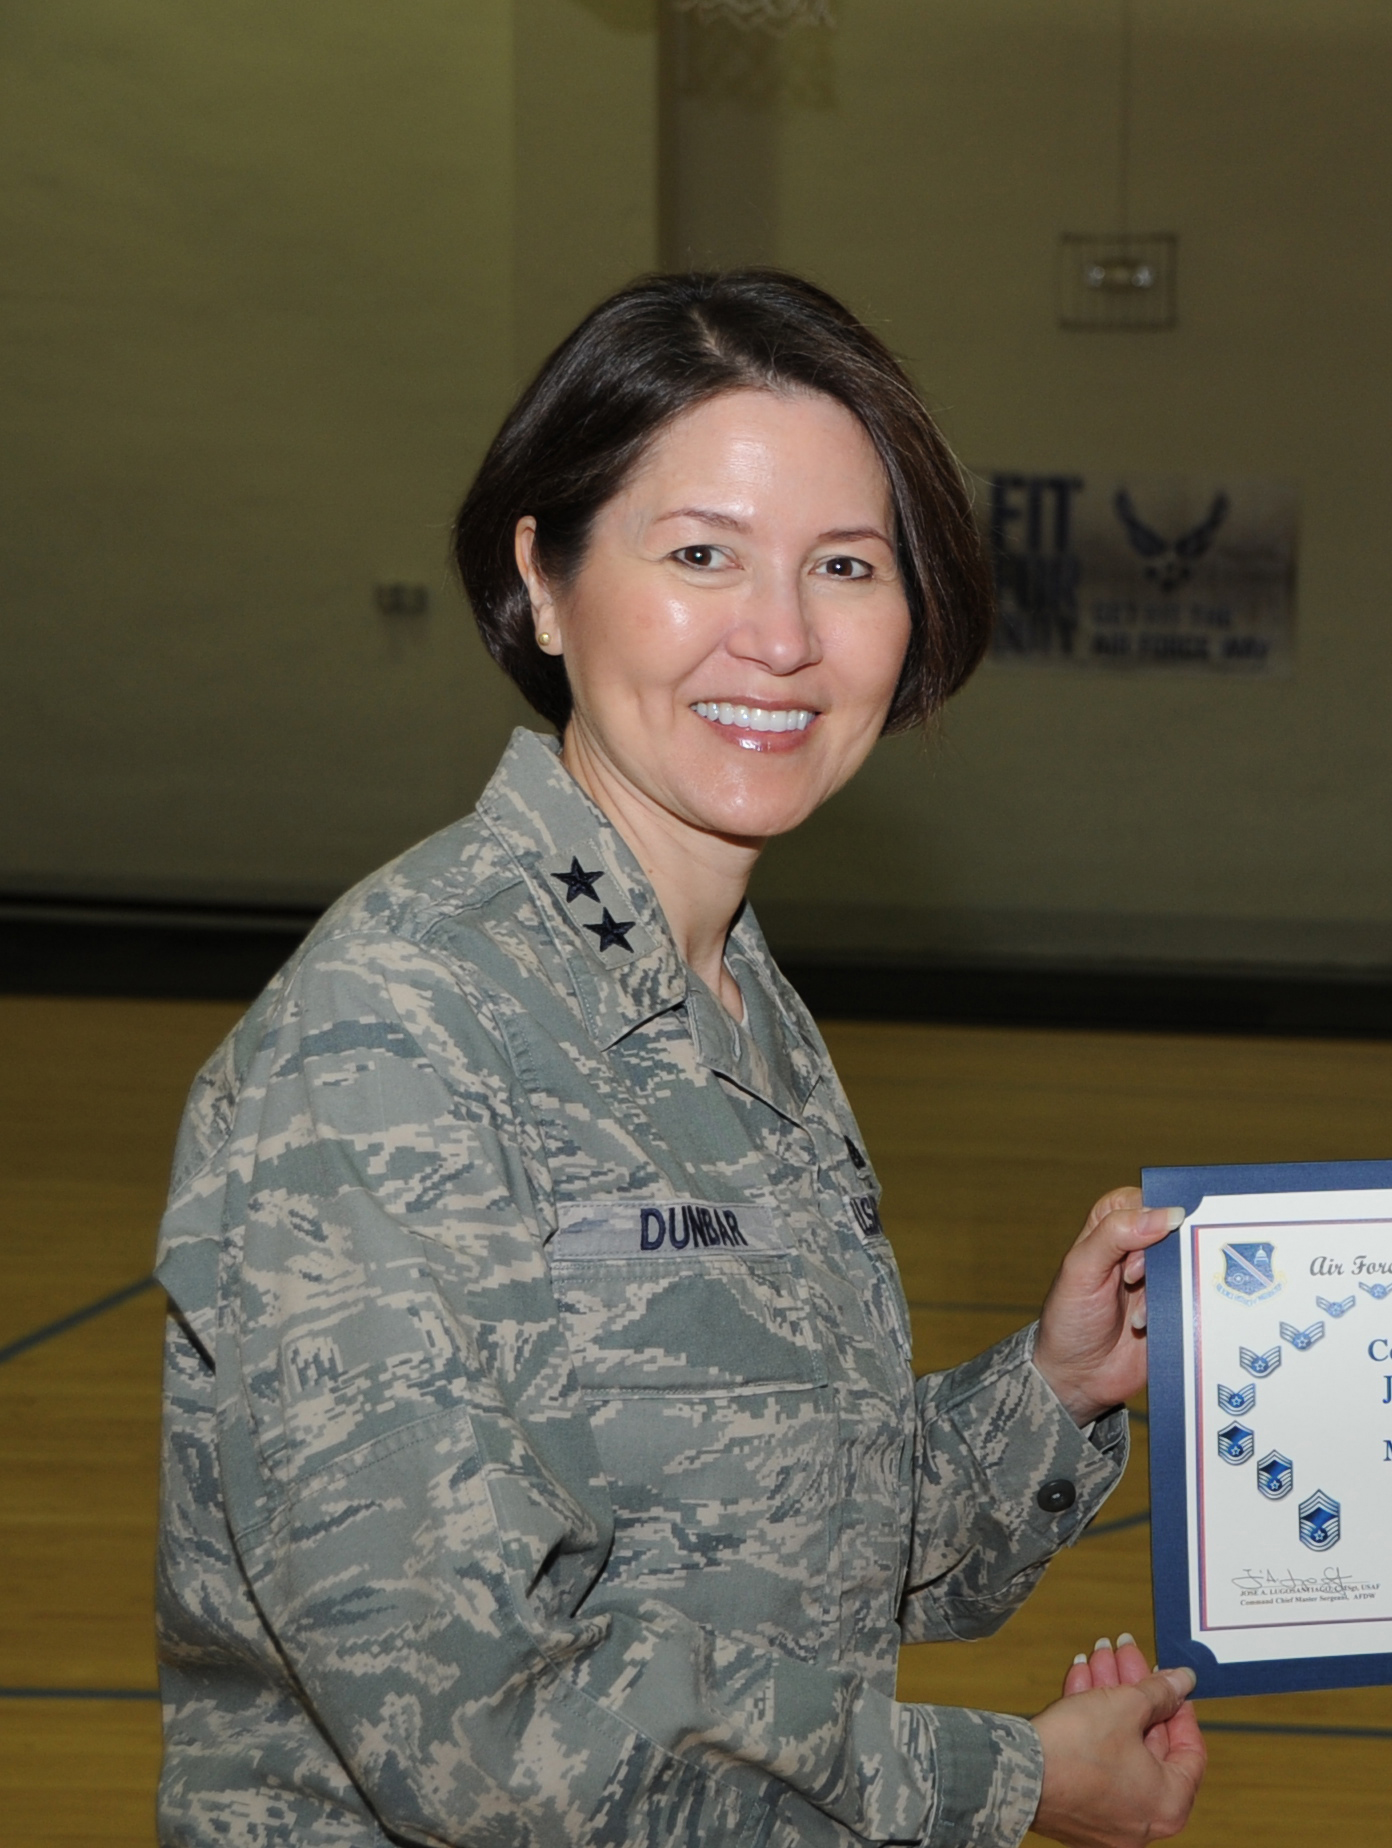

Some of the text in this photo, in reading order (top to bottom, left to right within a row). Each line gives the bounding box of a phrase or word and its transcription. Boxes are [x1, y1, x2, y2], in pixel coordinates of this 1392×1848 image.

[640, 1205, 749, 1251] DUNBAR
[1310, 1255, 1345, 1277] Air
[1361, 1583, 1381, 1591] USAF
[1240, 1598, 1274, 1606] Command
[1275, 1596, 1294, 1605] Chief
[1295, 1595, 1318, 1603] Master
[1353, 1592, 1376, 1600] AFDW
